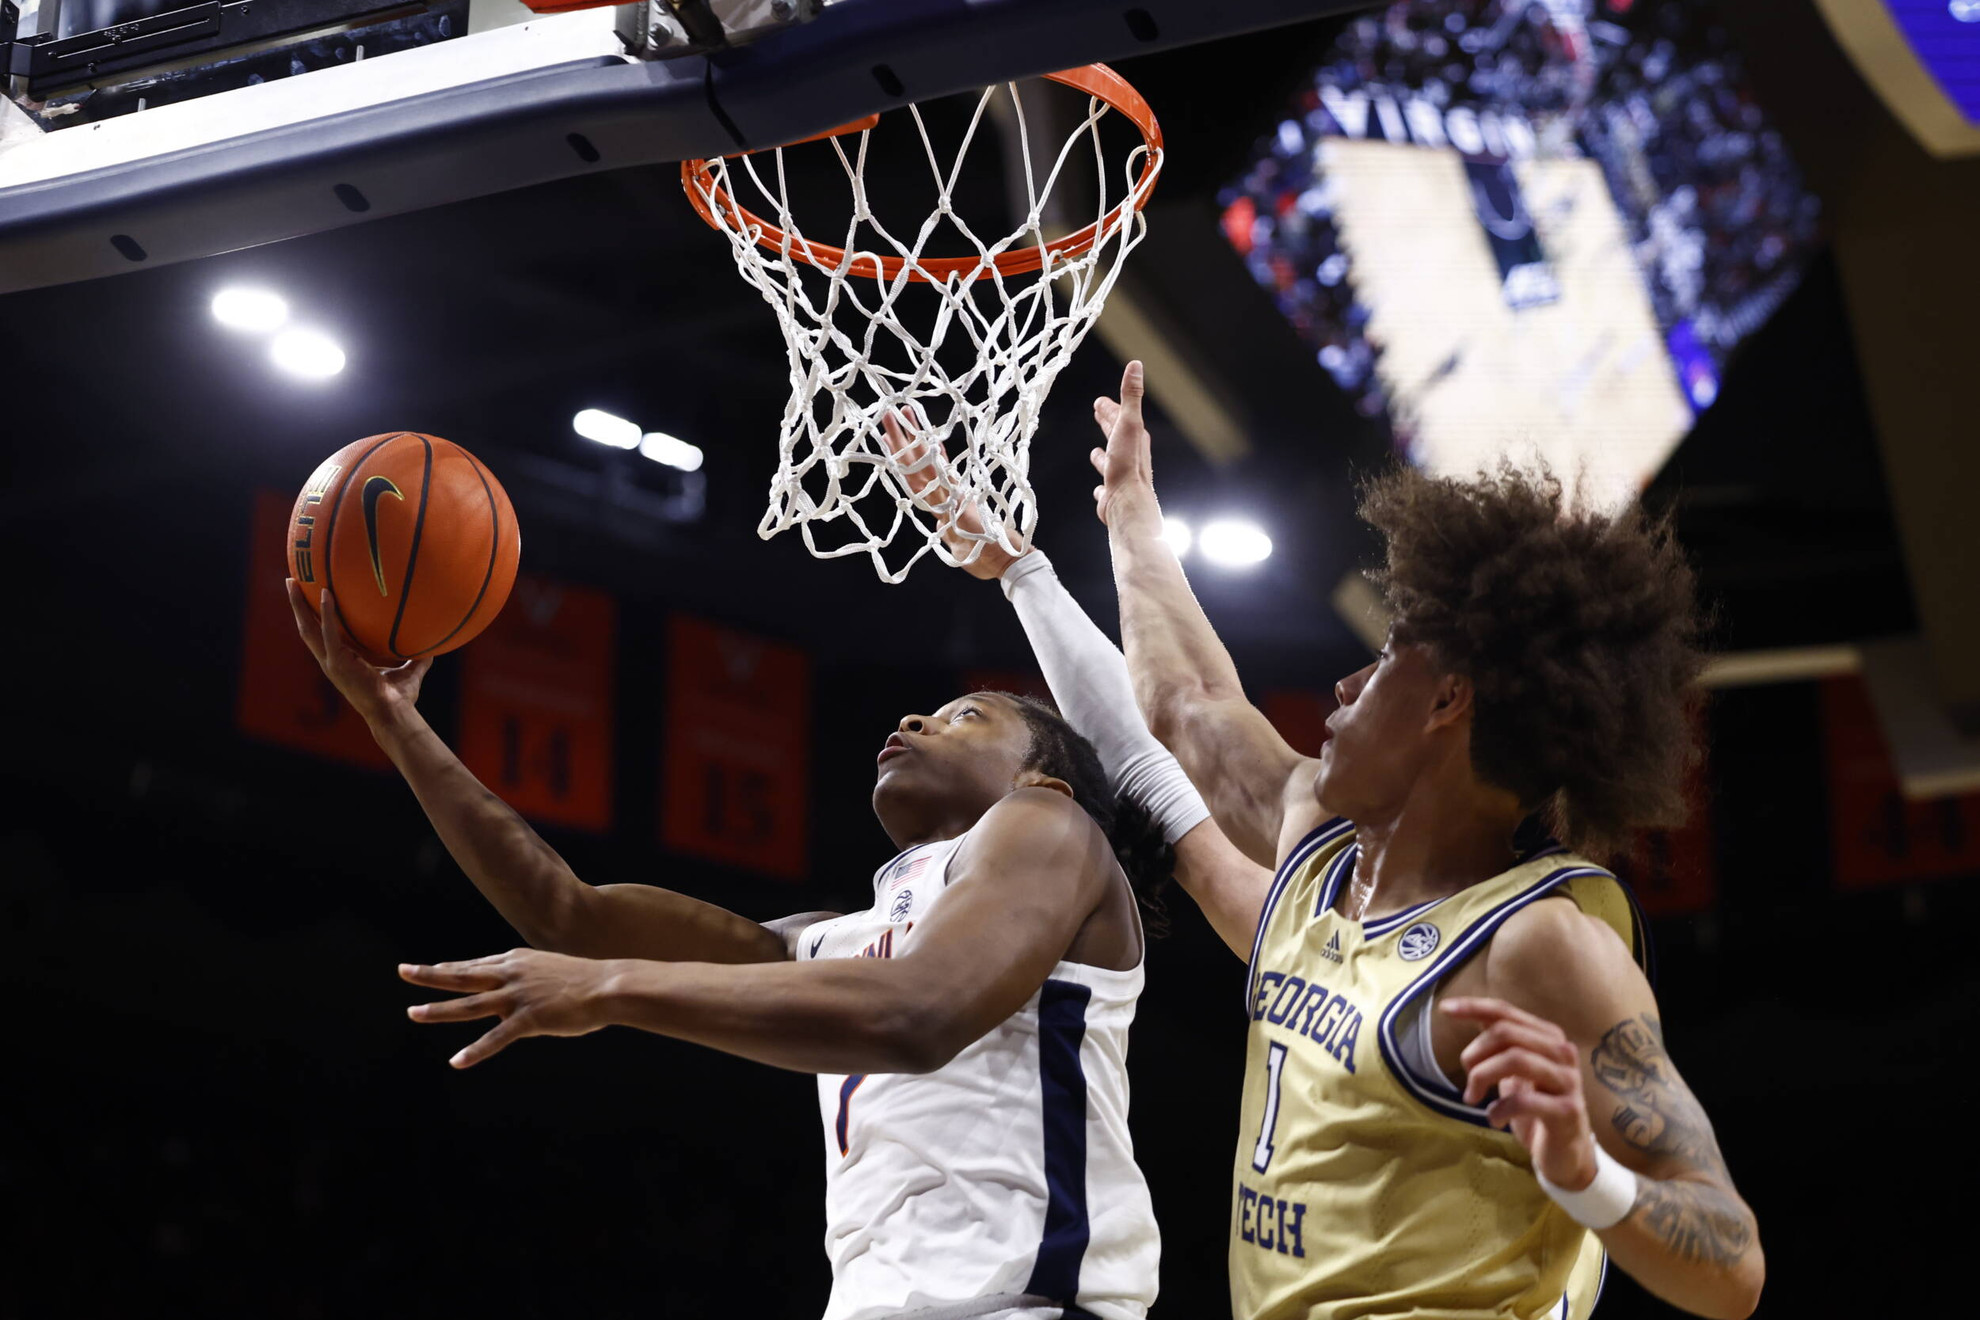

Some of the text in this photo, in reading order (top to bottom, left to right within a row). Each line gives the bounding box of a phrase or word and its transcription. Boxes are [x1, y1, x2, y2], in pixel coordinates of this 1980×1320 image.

[1318, 84, 1538, 159] VIRGIN
[295, 466, 341, 582] ELITE
[1252, 971, 1363, 1074] EORGIA
[1252, 1039, 1288, 1176] 1
